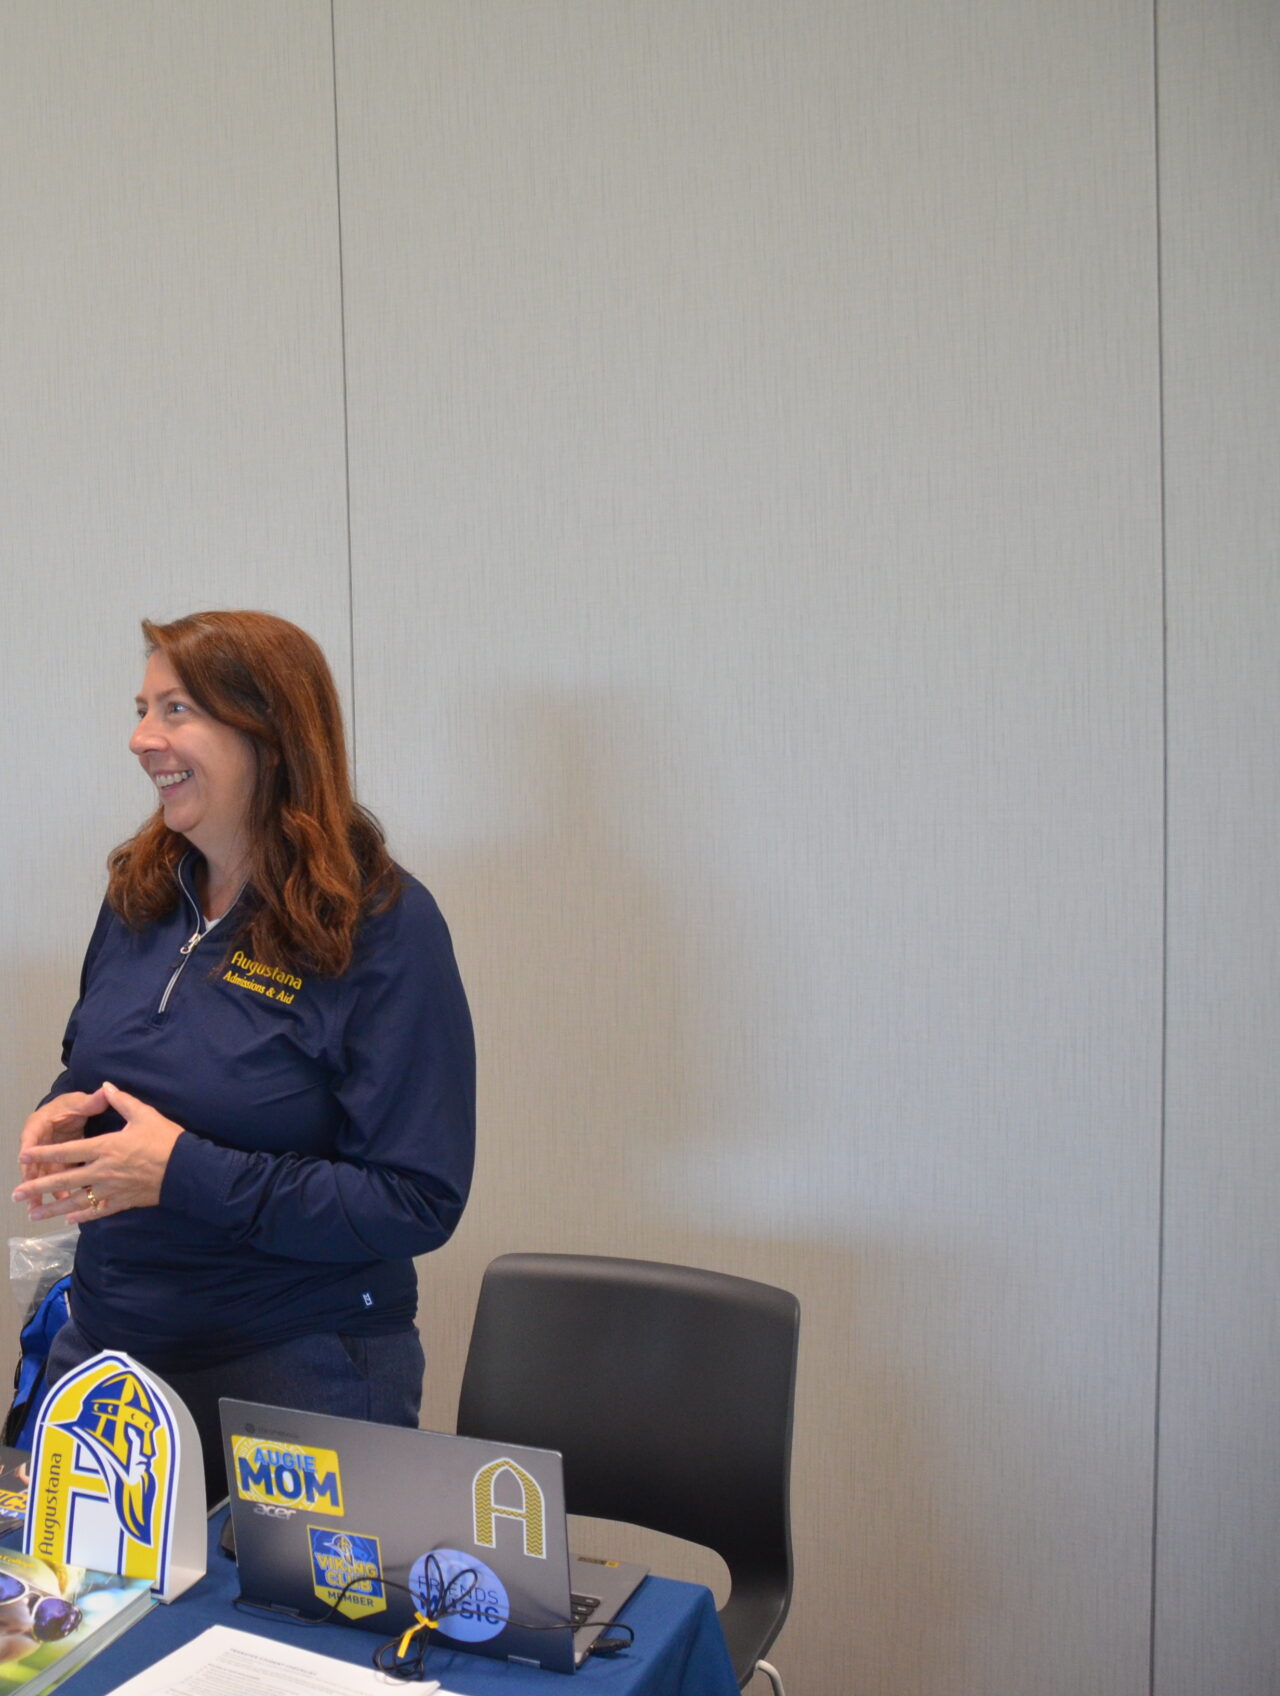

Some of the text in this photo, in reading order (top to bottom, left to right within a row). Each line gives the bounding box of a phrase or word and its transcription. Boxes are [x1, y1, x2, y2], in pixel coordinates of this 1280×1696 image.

[231, 951, 302, 990] Augustana
[223, 970, 294, 1005] Admissions & Aid
[254, 1448, 316, 1472] AUGIE
[238, 1456, 339, 1507] MOM
[38, 1453, 62, 1556] Augustana
[254, 1503, 296, 1519] acer
[315, 1553, 378, 1577] VIKING
[325, 1570, 372, 1592] CLUB
[418, 1576, 499, 1606] FRENDS
